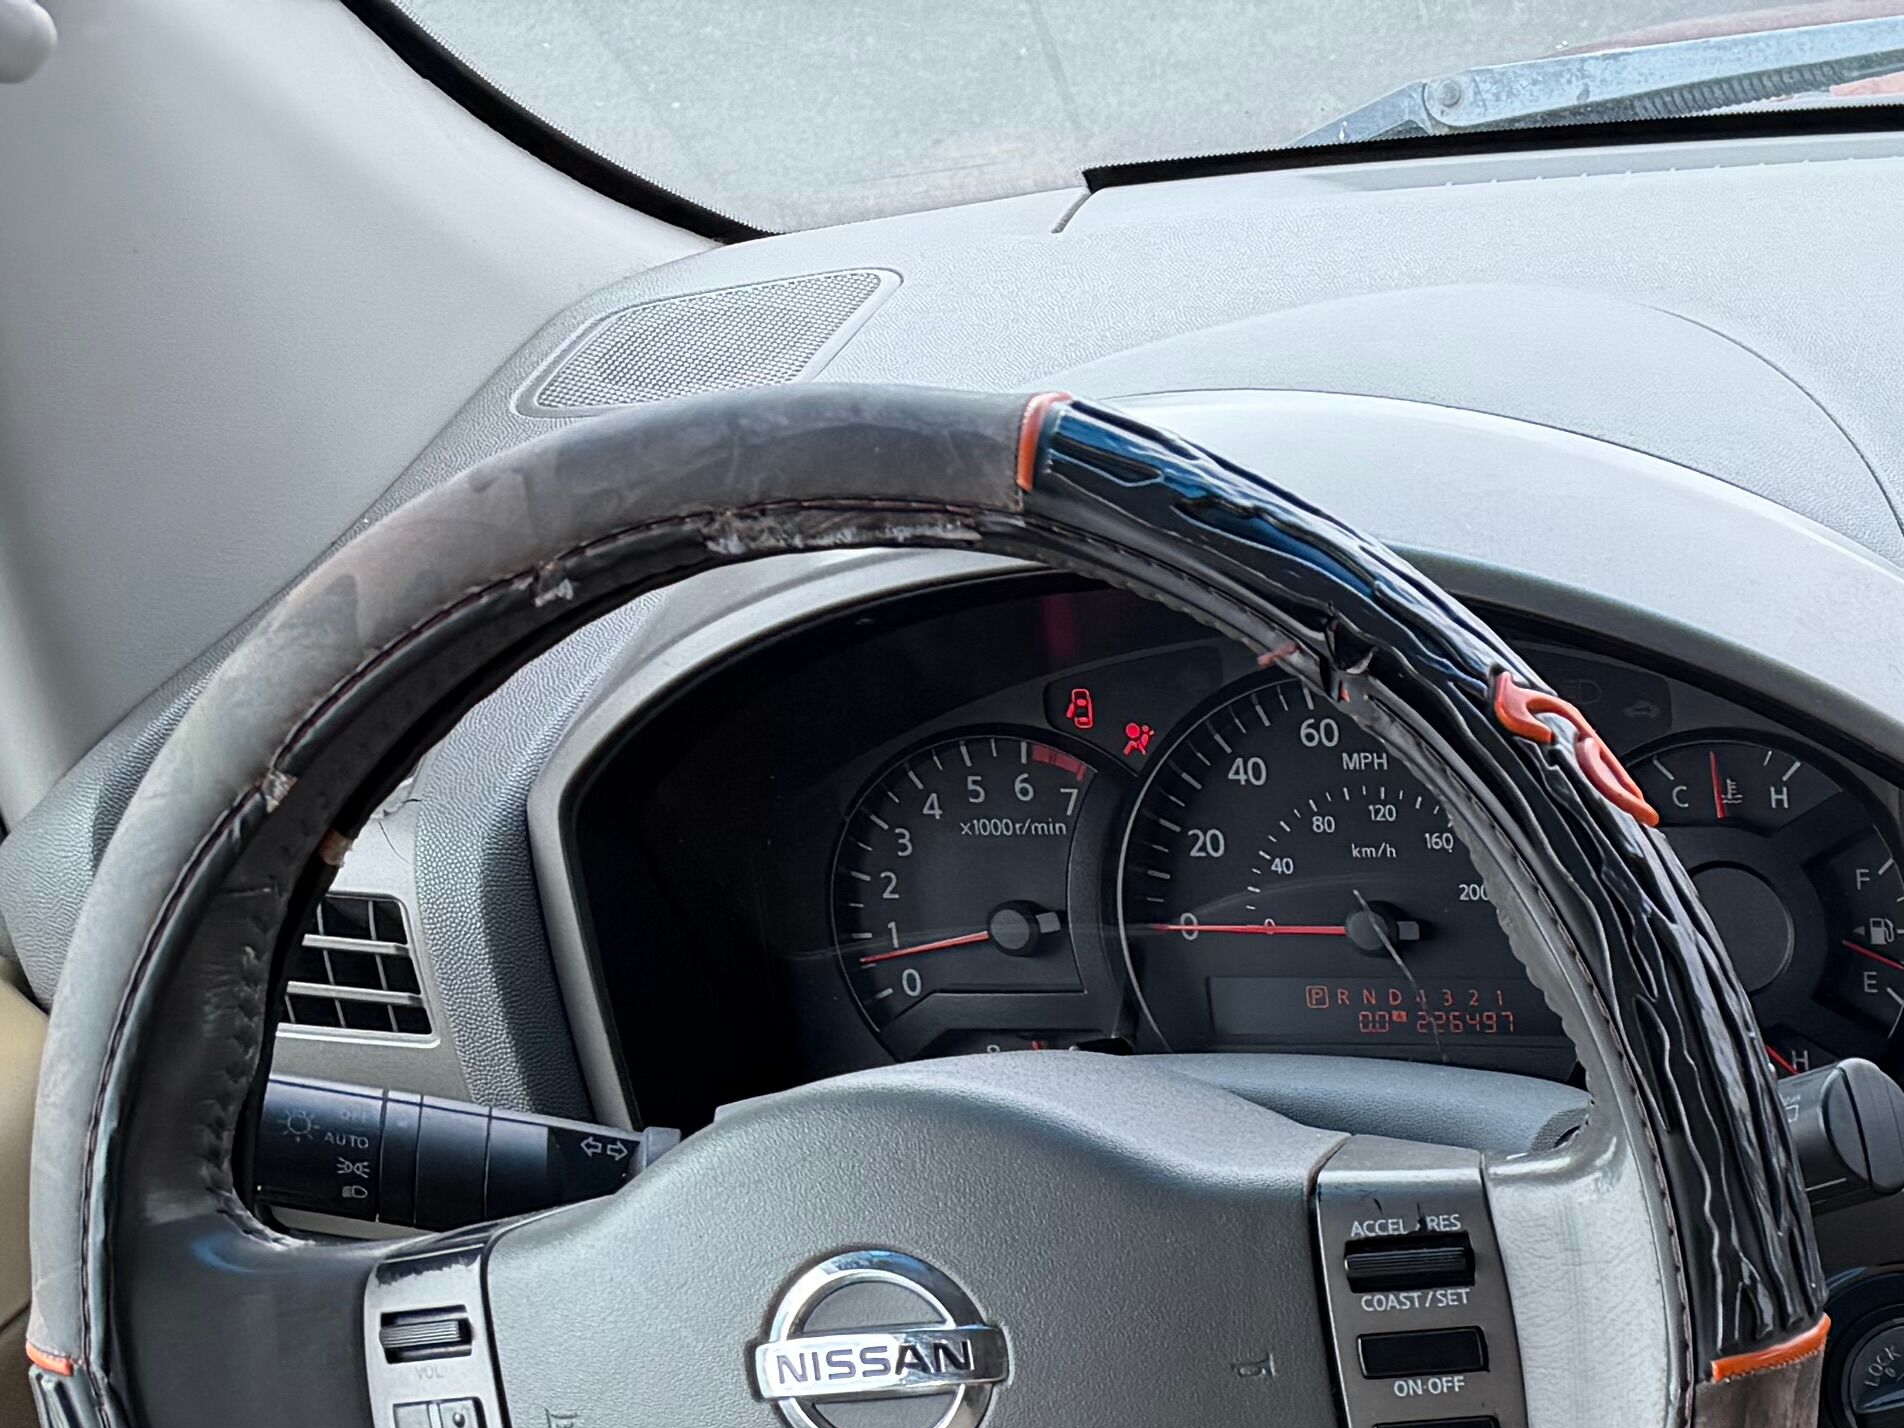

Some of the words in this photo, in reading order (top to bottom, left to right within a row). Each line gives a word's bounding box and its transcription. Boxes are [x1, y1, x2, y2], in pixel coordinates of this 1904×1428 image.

[1300, 718, 1339, 747] 60
[1228, 757, 1267, 785] 40
[1342, 752, 1388, 770] MPH
[967, 776, 986, 803] 5
[1014, 775, 1034, 801] 6
[1672, 786, 1689, 808] C
[1770, 786, 1789, 809] H
[922, 793, 943, 820] 4
[1060, 788, 1079, 815] 7
[1369, 804, 1397, 821] 120
[1312, 816, 1335, 833] 80
[895, 829, 913, 857] 3
[1187, 829, 1225, 857] 20
[1352, 843, 1396, 859] km/h
[1425, 833, 1454, 850] 160
[1271, 857, 1294, 874] 40
[883, 872, 900, 899] 2
[1856, 869, 1871, 890] F
[888, 922, 899, 948] 1
[1180, 912, 1199, 941] 0
[902, 969, 921, 996] 0
[1864, 972, 1878, 993] E
[1311, 989, 1323, 1005] P
[1337, 989, 1350, 1005] R
[1363, 989, 1376, 1005] N
[1388, 988, 1401, 1005] D
[1443, 989, 1452, 1006] 3
[1469, 989, 1479, 1006] 2
[1496, 990, 1504, 1006] 1
[1792, 1050, 1808, 1071] H
[324, 1131, 369, 1149] AUTO
[415, 1365, 444, 1380] VOL
[776, 1339, 975, 1385] NISSAN
[1863, 1345, 1902, 1387] LOCK
